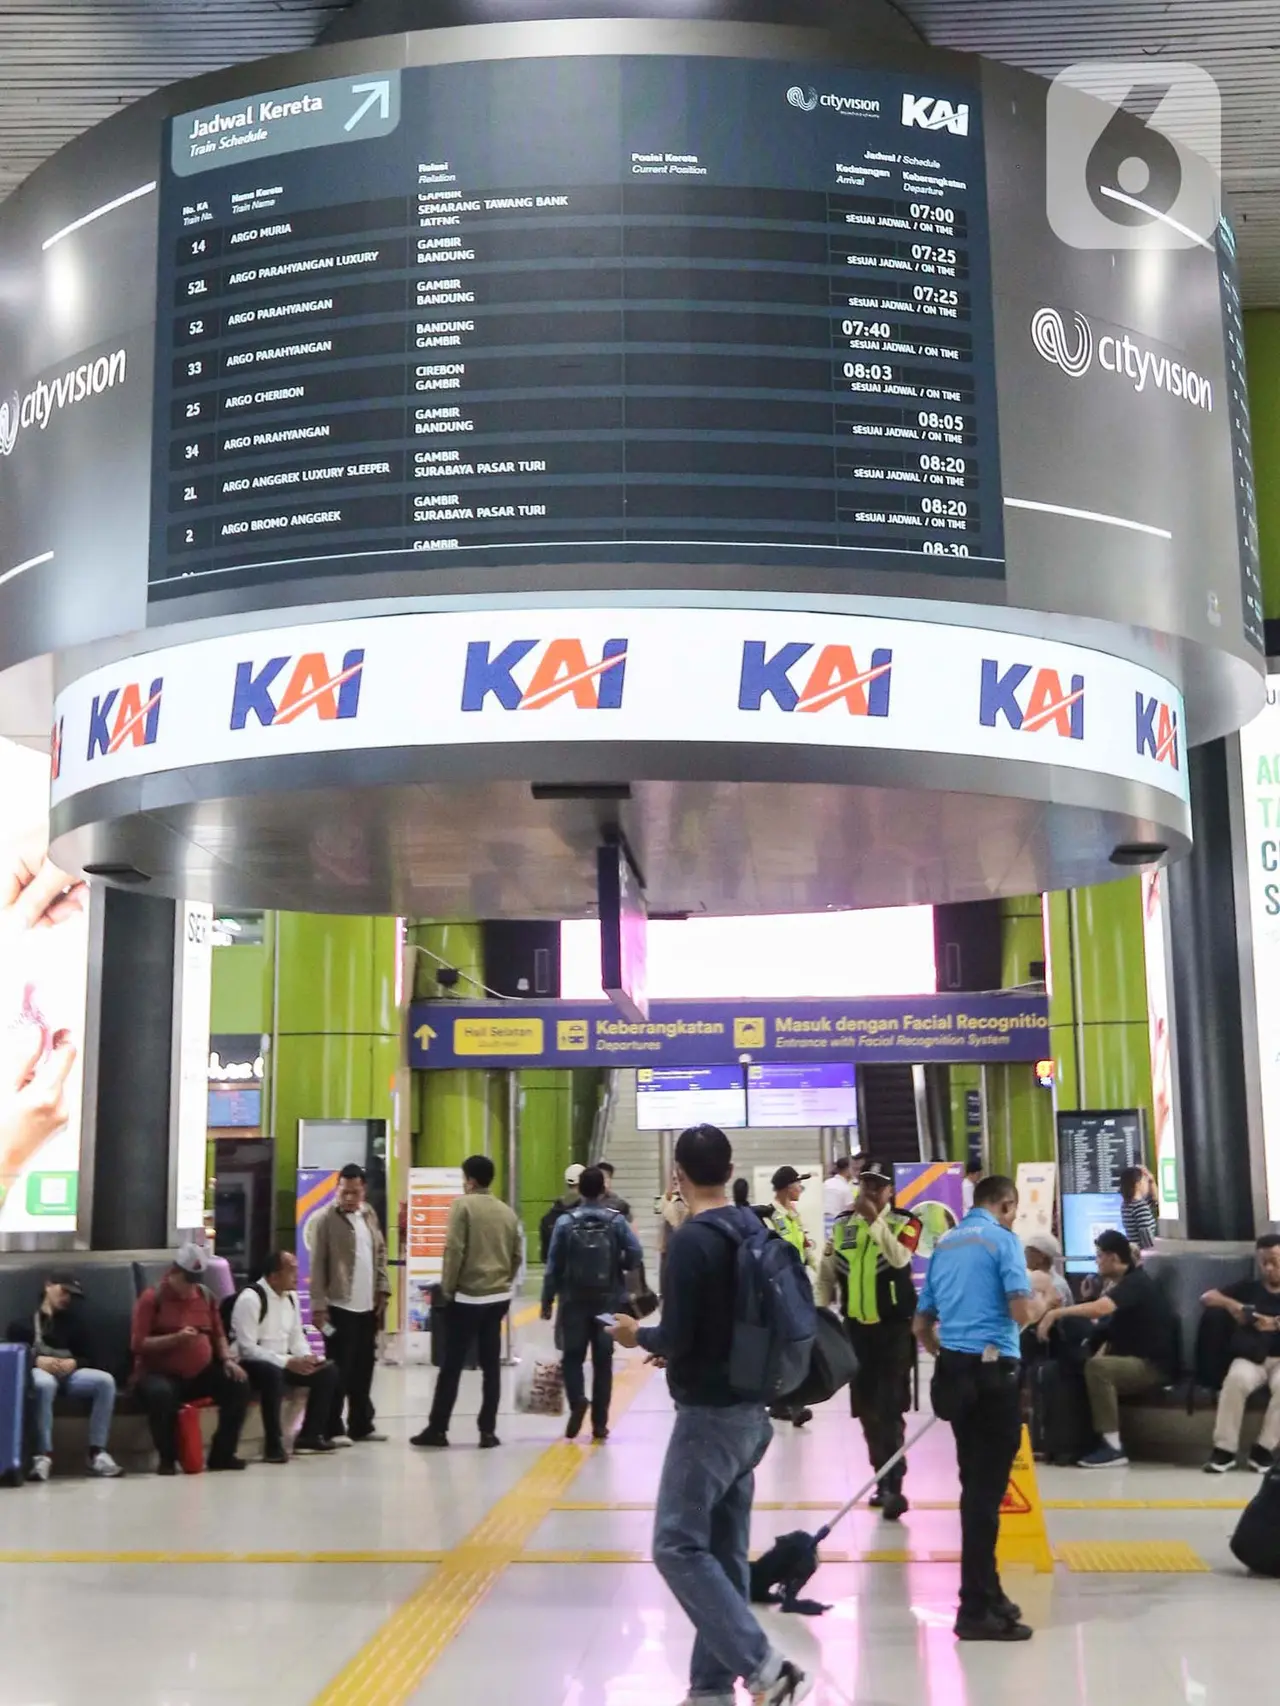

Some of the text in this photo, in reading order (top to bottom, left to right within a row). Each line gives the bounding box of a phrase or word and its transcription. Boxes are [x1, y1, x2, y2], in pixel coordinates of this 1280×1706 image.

[820, 94, 880, 111] cityvision
[190, 94, 322, 140] Jadwal Kereta
[902, 93, 969, 136] KAI
[190, 127, 267, 157] Train Schedule
[864, 151, 895, 162] Jadwal
[902, 156, 940, 168] Schedule
[418, 174, 456, 183] Relation
[632, 165, 707, 175] Current Position
[836, 164, 890, 178] Kedatangan
[836, 175, 864, 186] Arrival
[904, 183, 943, 196] Departure
[232, 203, 250, 213] Train
[418, 196, 568, 214] SEMARANG TAWANG BANK
[910, 203, 954, 223] 07:00
[230, 224, 292, 244] ARGO MURIA
[846, 215, 875, 225] SESUAI
[877, 217, 911, 229] JADWAL
[920, 223, 933, 233] ON
[935, 225, 953, 236] TIME
[192, 240, 206, 254] 14
[418, 238, 461, 249] GAMBIR
[417, 250, 474, 263] BANDUNG
[912, 245, 956, 264] 07:25
[230, 252, 379, 284] ARGO PARAHYANGAN LUXURY
[847, 256, 877, 267] SESUAI
[879, 259, 912, 271] JADWAL
[921, 264, 935, 274] ON
[937, 266, 955, 277] TIME
[417, 279, 461, 291] GAMBIR
[417, 292, 474, 305] BANDUNG
[914, 286, 958, 305] 07:25
[228, 299, 332, 326] ARGO PARAHYANGAN
[849, 298, 878, 308] SESUAI
[880, 300, 914, 312] JADWAL
[923, 305, 936, 314] ON
[938, 308, 957, 318] TIME
[189, 321, 203, 334] 52
[416, 321, 474, 334] BANDUNG
[842, 320, 890, 338] 07:40
[416, 336, 461, 348] GAMBIR
[850, 340, 879, 350] SESUAI
[882, 343, 916, 354] JADWAL
[925, 346, 938, 356] ON
[940, 349, 959, 360] TIME
[227, 341, 331, 367] ARGO PARAHYANGAN
[188, 362, 202, 376] 33
[416, 364, 464, 376] CIREBON
[844, 363, 892, 380] 08:03
[1099, 334, 1212, 412] cityvision
[21, 349, 126, 429] cityvision
[416, 378, 460, 390] GAMBIR
[851, 382, 881, 393] SESUAI
[883, 385, 917, 397] JADWAL
[926, 389, 940, 399] ON
[942, 391, 961, 402] TIME
[225, 386, 304, 408] ARGO CHERIBON
[186, 403, 200, 417] 25
[415, 408, 460, 420] GAMBIR
[415, 421, 474, 434] BANDUNG
[918, 412, 964, 430] 08:05
[224, 425, 329, 450] ARGO PARAHYANGAN
[853, 425, 882, 435] SESUAI
[884, 428, 919, 440] JADWAL
[928, 432, 941, 442] ON
[944, 433, 962, 444] TIME
[185, 444, 199, 458] 34
[414, 451, 460, 463] GAMBIR
[414, 461, 545, 478] SURABAYA PASAR TURI
[920, 455, 965, 473] 08:20
[223, 462, 390, 492] ARGO ANGGREK LUXURY SLEEPER
[854, 469, 884, 479] SESUAI
[886, 471, 920, 482] JADWAL
[930, 475, 943, 484] ON
[945, 476, 964, 487] TIME
[414, 495, 459, 507] GAMBIR
[922, 498, 967, 516] 08:20
[414, 505, 545, 521] SURABAYA PASAR TURI
[855, 512, 885, 522] SESUAI
[887, 515, 922, 526] JADWAL
[931, 518, 945, 528] ON
[947, 520, 966, 530] TIME
[222, 511, 341, 535] ARGO BROMO ANGGREK
[186, 529, 193, 542] 2
[413, 539, 459, 550] GAMBIR
[923, 542, 968, 557] 08:30
[460, 638, 628, 712] KAI
[738, 640, 892, 716] KAI
[230, 648, 365, 730] KAI
[979, 658, 1084, 740] KAI
[86, 677, 164, 760] KAI
[1136, 692, 1179, 770] KAI
[596, 1020, 724, 1037] Keberangkatan
[776, 1013, 1048, 1036] Masuk dengan Facial Recognitio
[596, 1039, 662, 1051] Departures
[776, 1035, 1009, 1048] Entrance with Facial Recognition System
